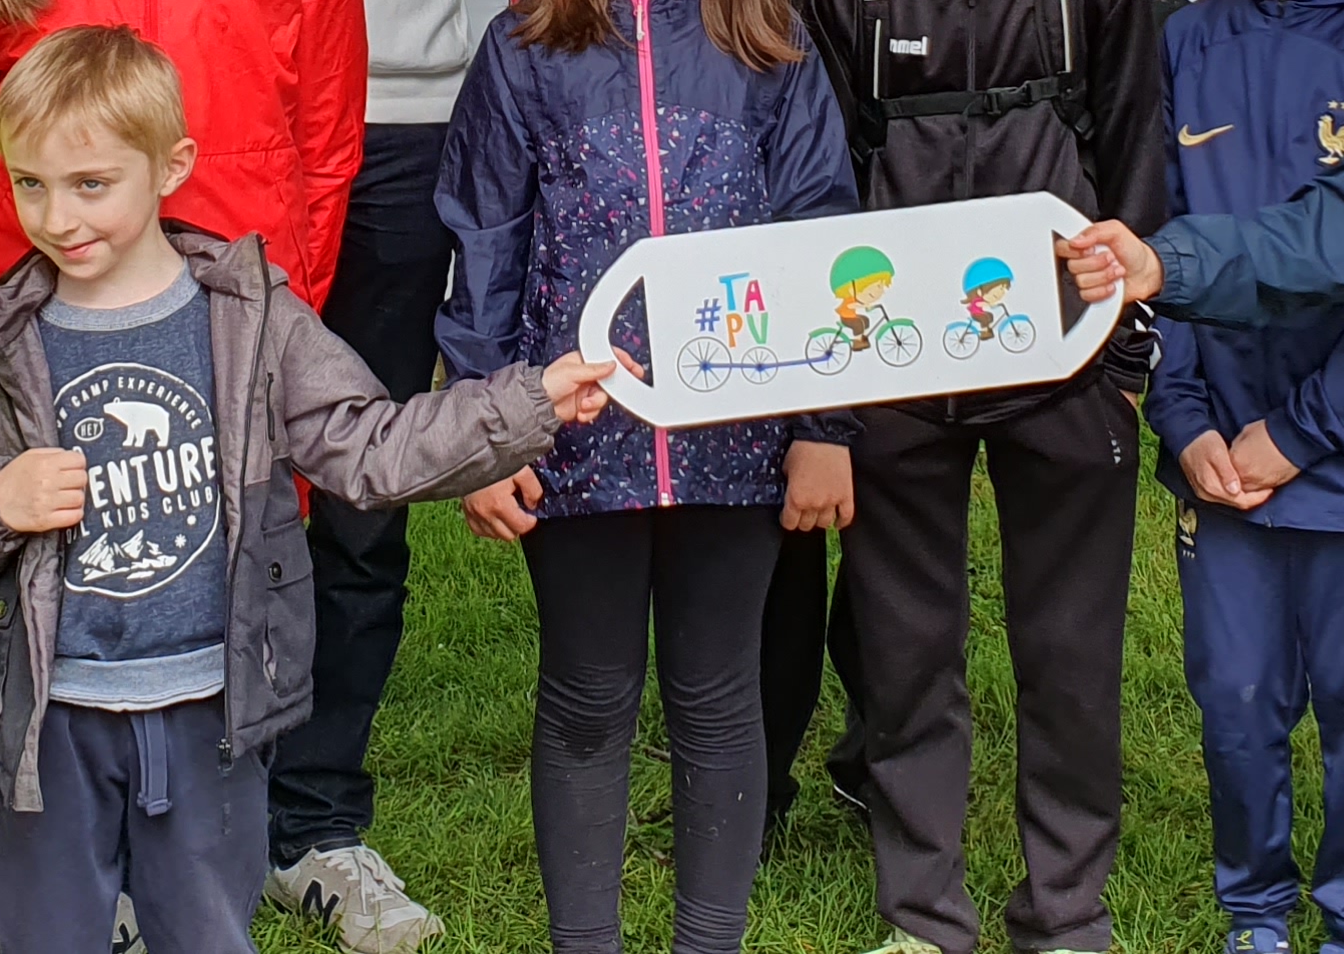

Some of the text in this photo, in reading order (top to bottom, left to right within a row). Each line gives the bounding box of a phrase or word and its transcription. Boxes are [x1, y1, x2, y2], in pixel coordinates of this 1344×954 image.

[71, 379, 109, 408] CAMP
[117, 376, 202, 430] EXPERIENCE
[80, 422, 98, 437] HEY
[102, 501, 150, 529] KIDS
[162, 485, 214, 515] CLUB
